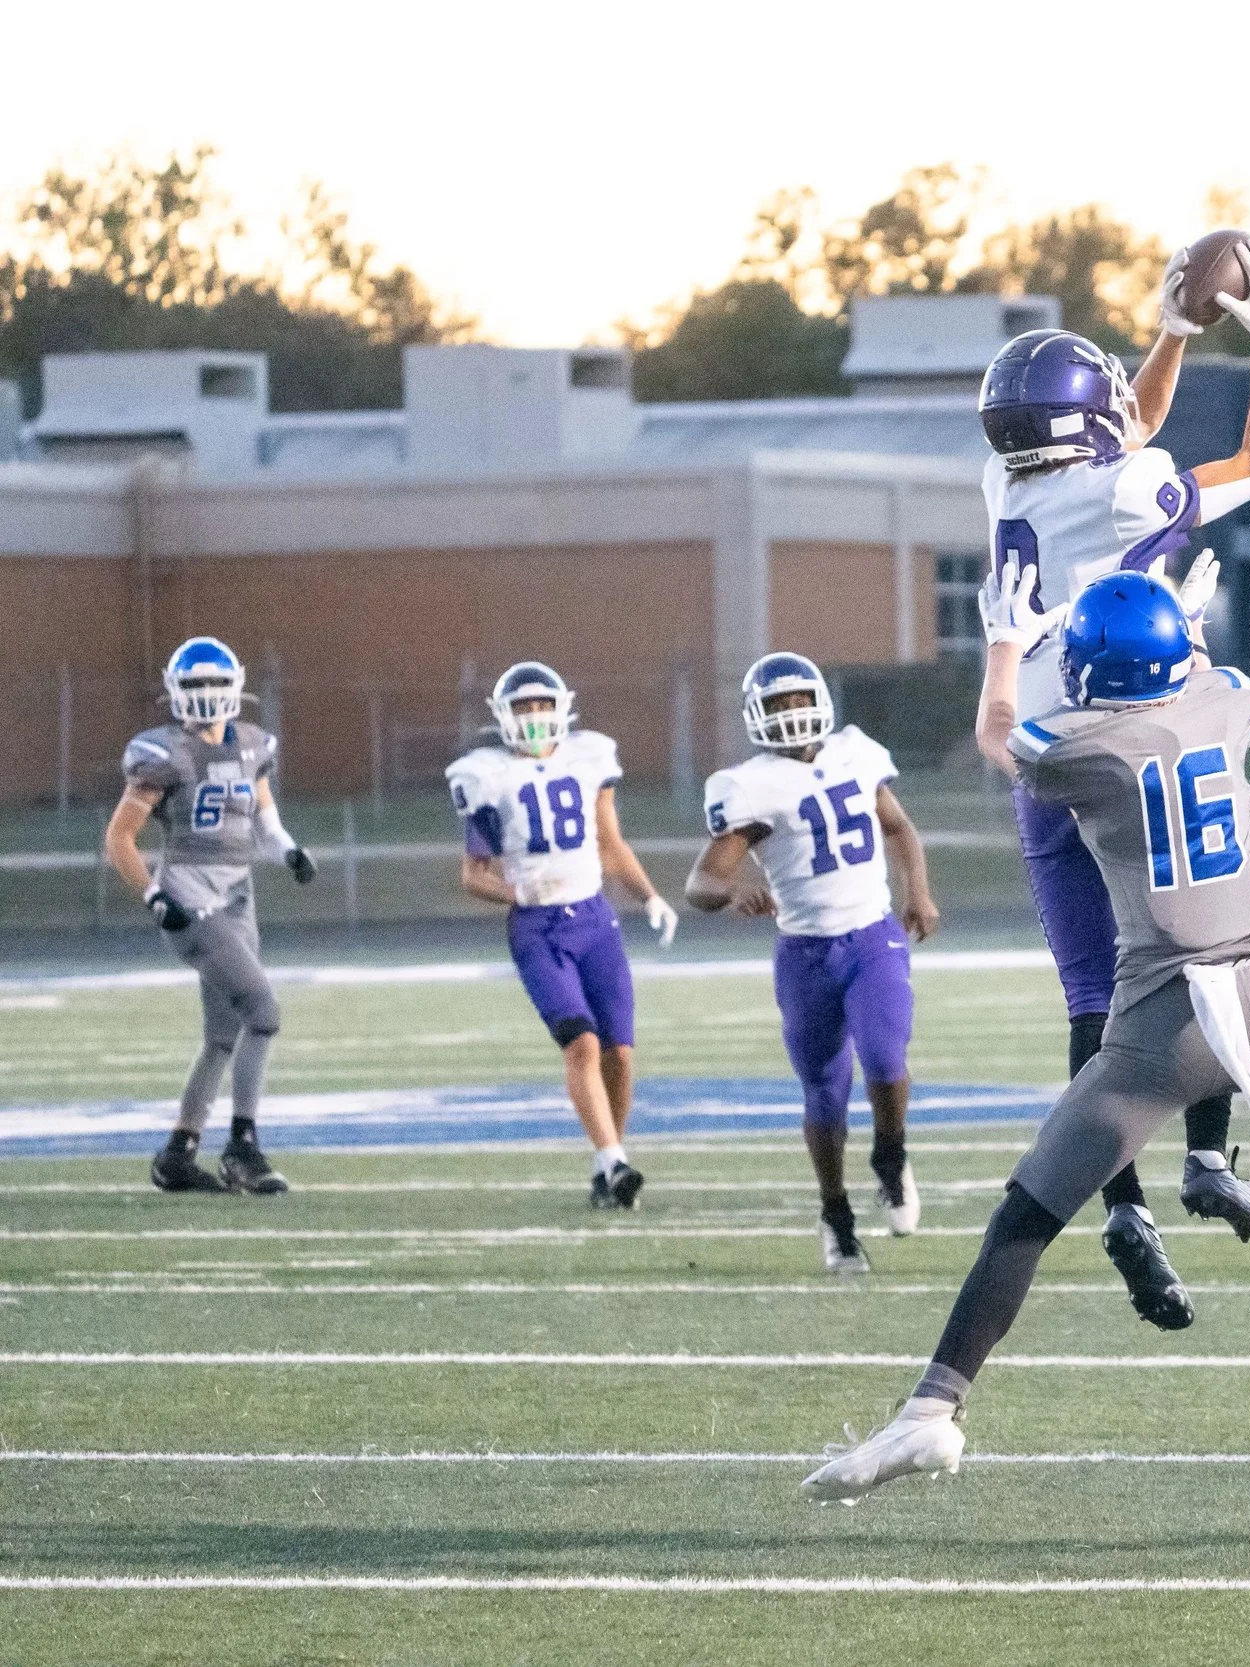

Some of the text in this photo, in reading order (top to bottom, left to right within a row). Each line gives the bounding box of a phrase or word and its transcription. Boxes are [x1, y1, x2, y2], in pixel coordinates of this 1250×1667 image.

[1006, 451, 1041, 466] schutt
[1149, 662, 1161, 675] 16
[517, 775, 586, 855] 18
[798, 779, 875, 877] 15
[1137, 742, 1248, 892] 16
